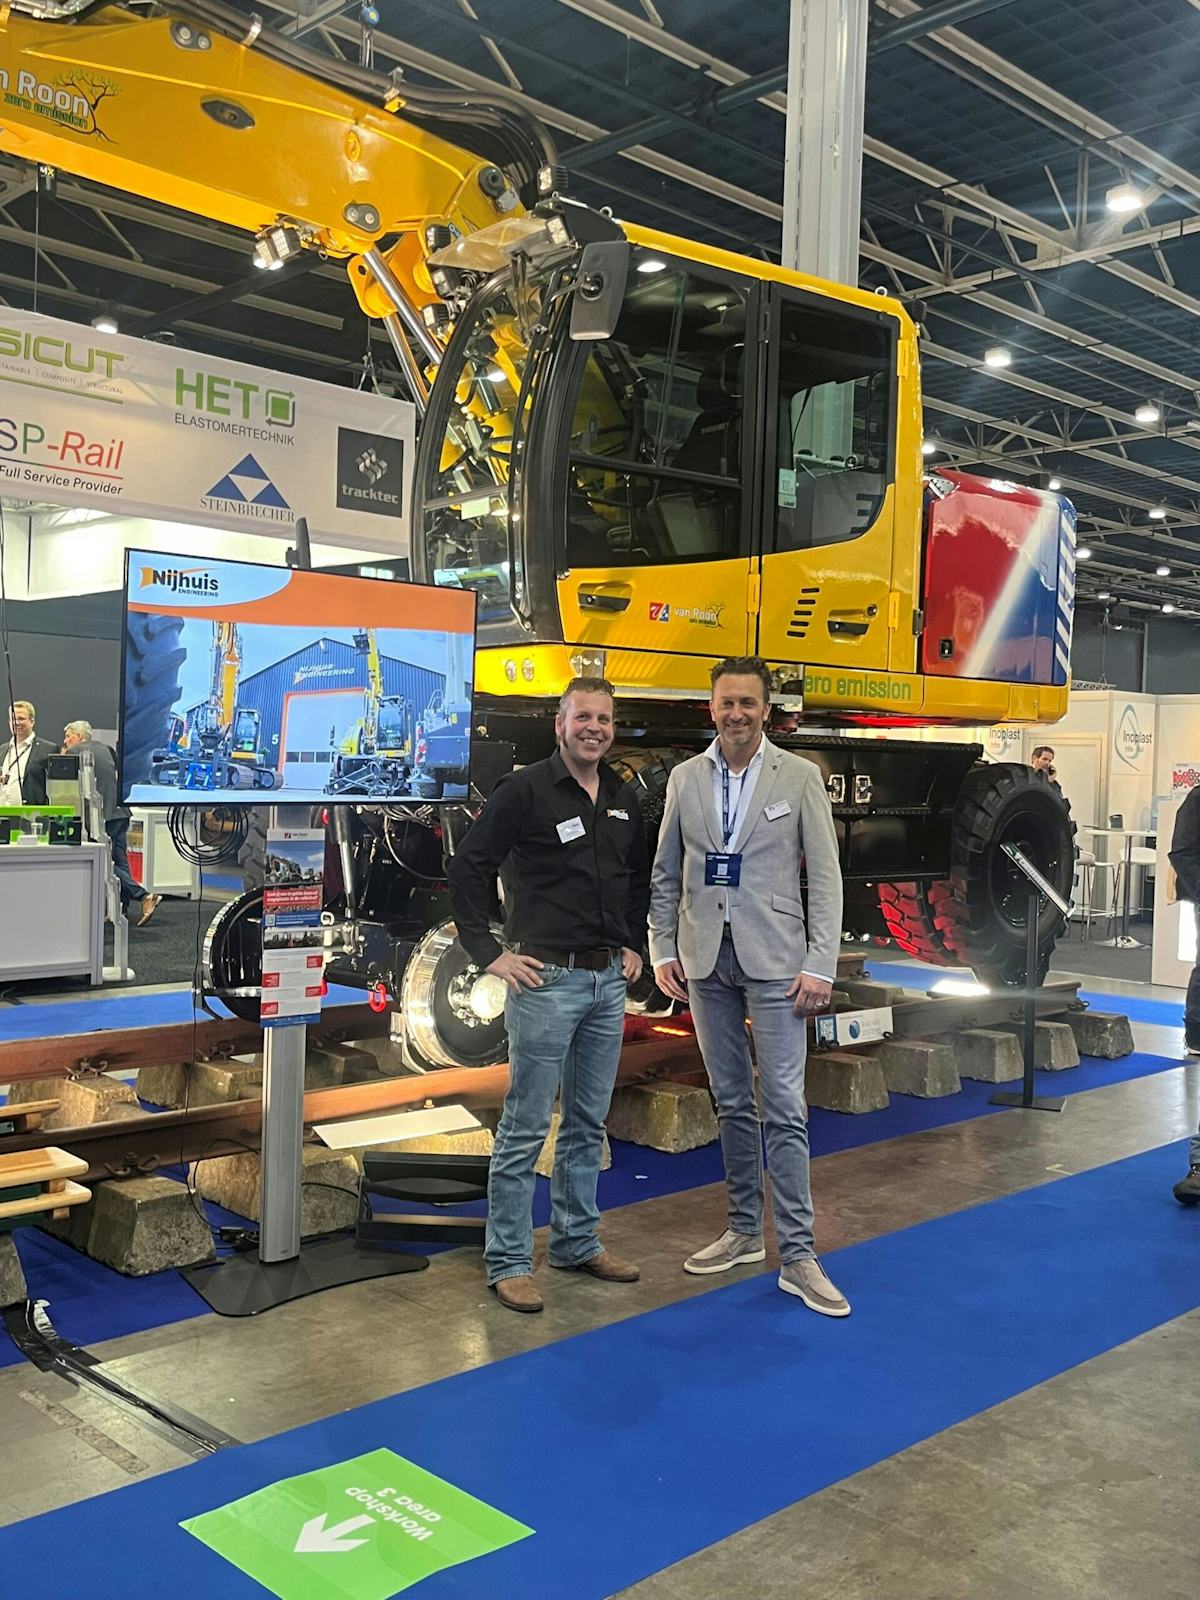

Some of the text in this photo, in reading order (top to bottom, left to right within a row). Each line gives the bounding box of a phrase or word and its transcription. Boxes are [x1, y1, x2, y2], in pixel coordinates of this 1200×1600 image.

[17, 69, 90, 118] Roon
[4, 92, 88, 129] zero emission
[0, 326, 125, 378] SICUT
[0, 361, 123, 395] TAINABLE COMPOSITE STRUCTURAL
[0, 418, 124, 470] SP-Rail
[174, 412, 295, 447] ELASTOMERTECHNIK
[0, 464, 123, 495] Full Service Provider
[200, 496, 295, 522] STEINBRECHER
[341, 484, 399, 505] tracktec
[152, 569, 219, 592] Nijhuis
[178, 588, 219, 598] ENGINEERING
[674, 607, 717, 621] van Roon
[803, 673, 912, 700] ero emission
[271, 733, 279, 745] 5
[989, 727, 1021, 741] Inoplast
[1122, 730, 1152, 745] Inoplast
[344, 1487, 434, 1541] Workshop
[376, 1487, 442, 1522] area 3
